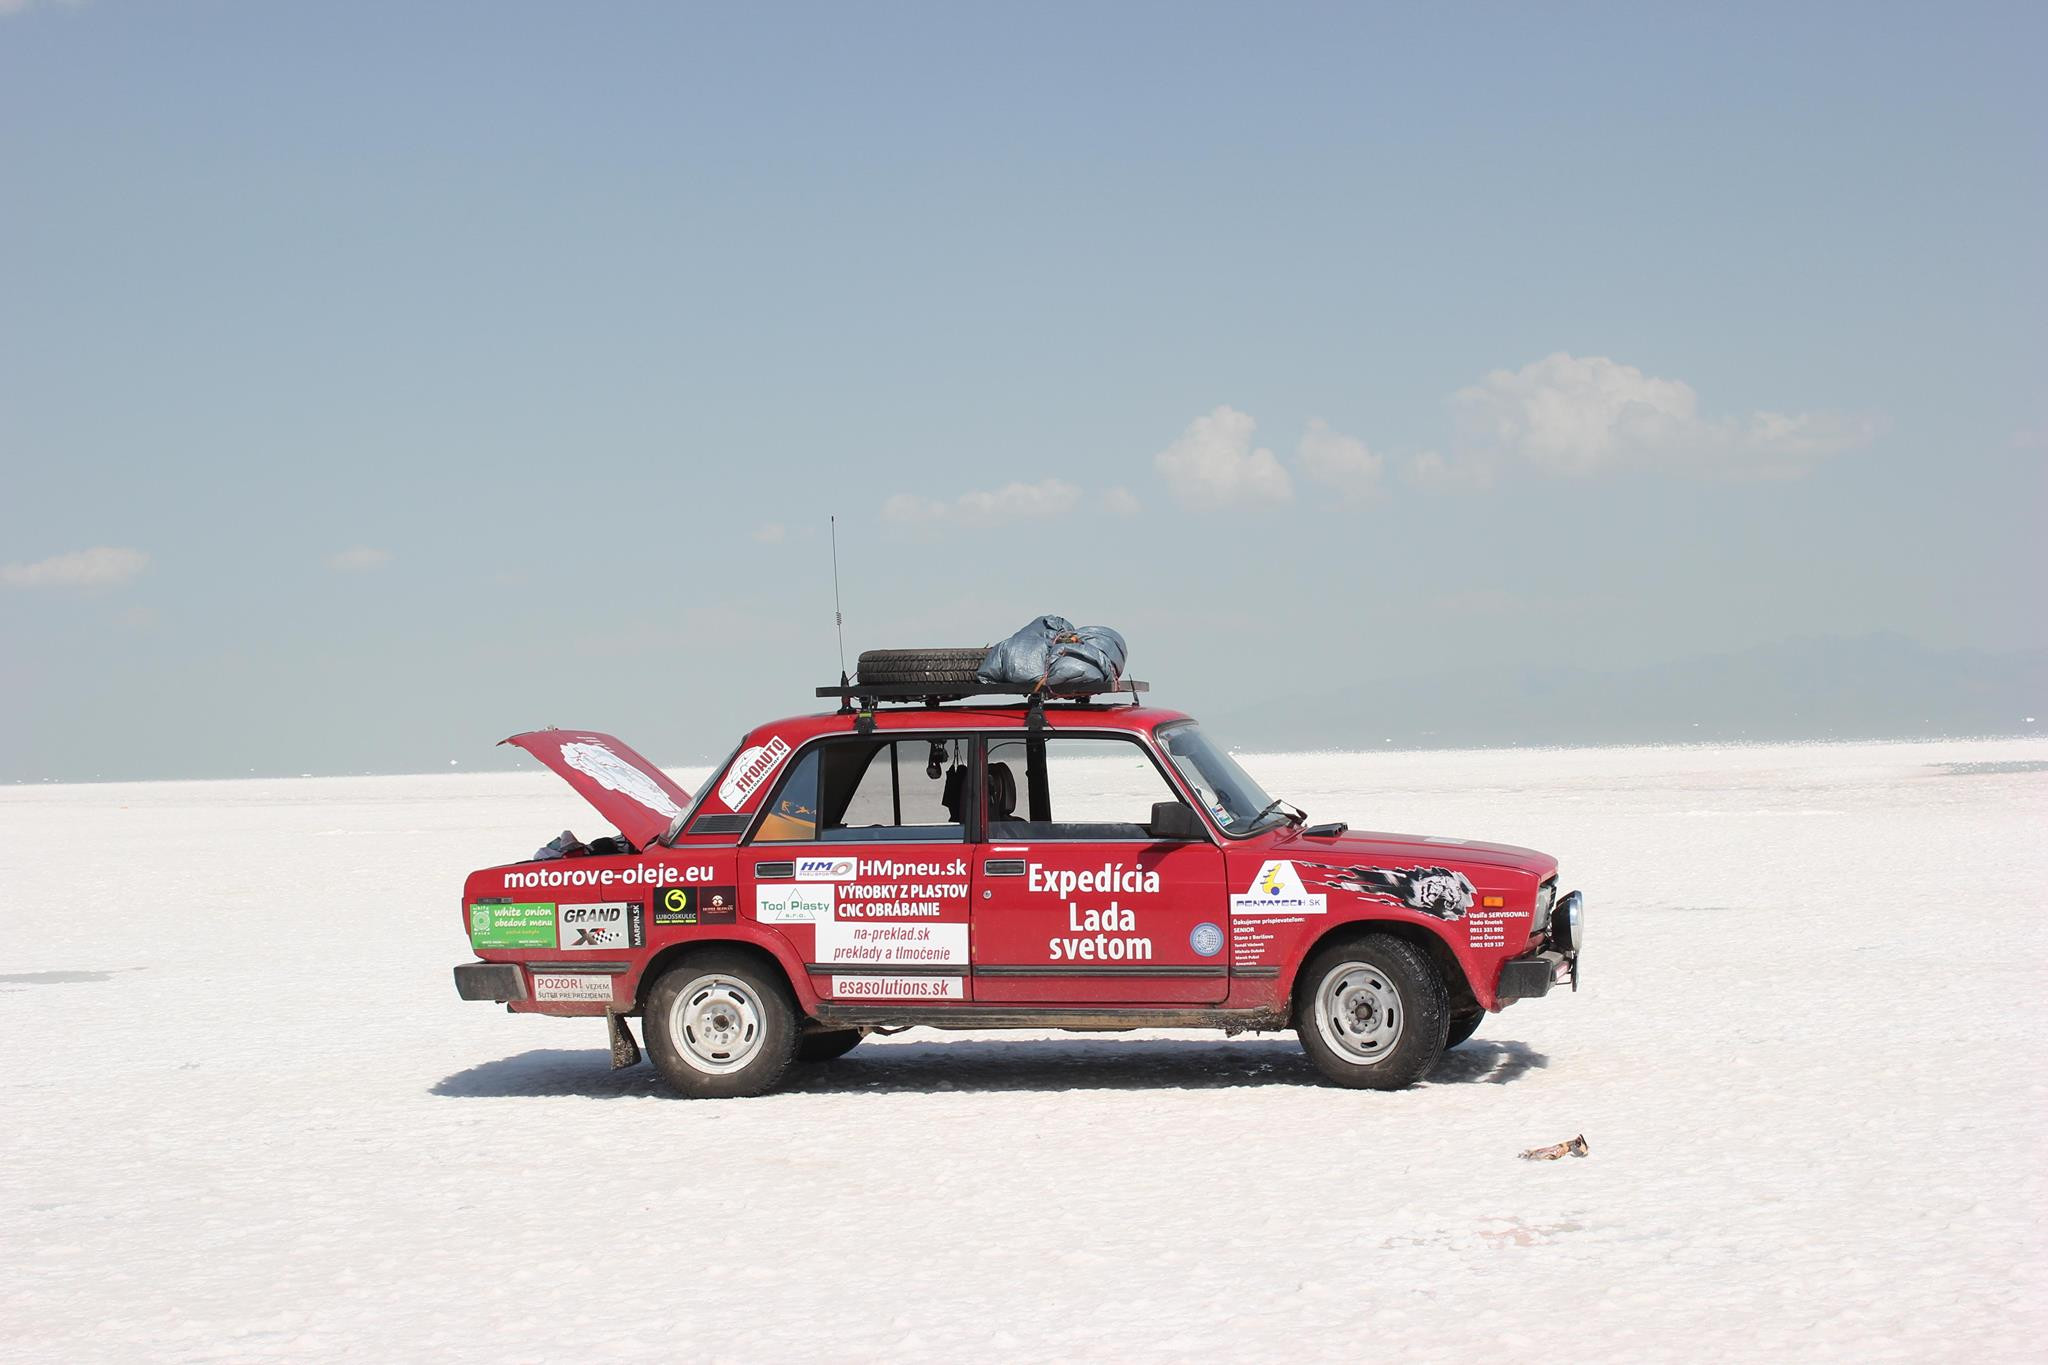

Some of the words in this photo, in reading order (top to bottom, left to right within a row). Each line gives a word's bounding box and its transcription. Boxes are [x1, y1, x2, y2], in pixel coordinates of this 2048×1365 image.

[736, 739, 785, 793] FIFOAUTO
[503, 863, 714, 889] motorove-oleje.eu
[859, 858, 967, 880] HMpneu.sk
[1028, 862, 1160, 900] Expedícia
[838, 882, 898, 899] VÝROBKY
[899, 886, 909, 898] Z
[911, 884, 968, 899] PLASTOV
[525, 906, 552, 917] onion
[564, 908, 621, 923] GRAND
[761, 901, 787, 912] Tool
[791, 901, 830, 913] Plasty
[838, 903, 864, 918] CNC
[866, 900, 941, 917] OBRÁBANIE
[529, 919, 552, 927] menu
[1069, 901, 1136, 932] Lada
[853, 926, 931, 943] na-preklad.sk
[833, 946, 882, 962] preklady
[885, 950, 892, 960] a
[895, 945, 951, 961] tlmočenie
[1049, 934, 1153, 960] svetom
[537, 978, 583, 989] POZOR!
[839, 978, 950, 996] esasolutions.sk
